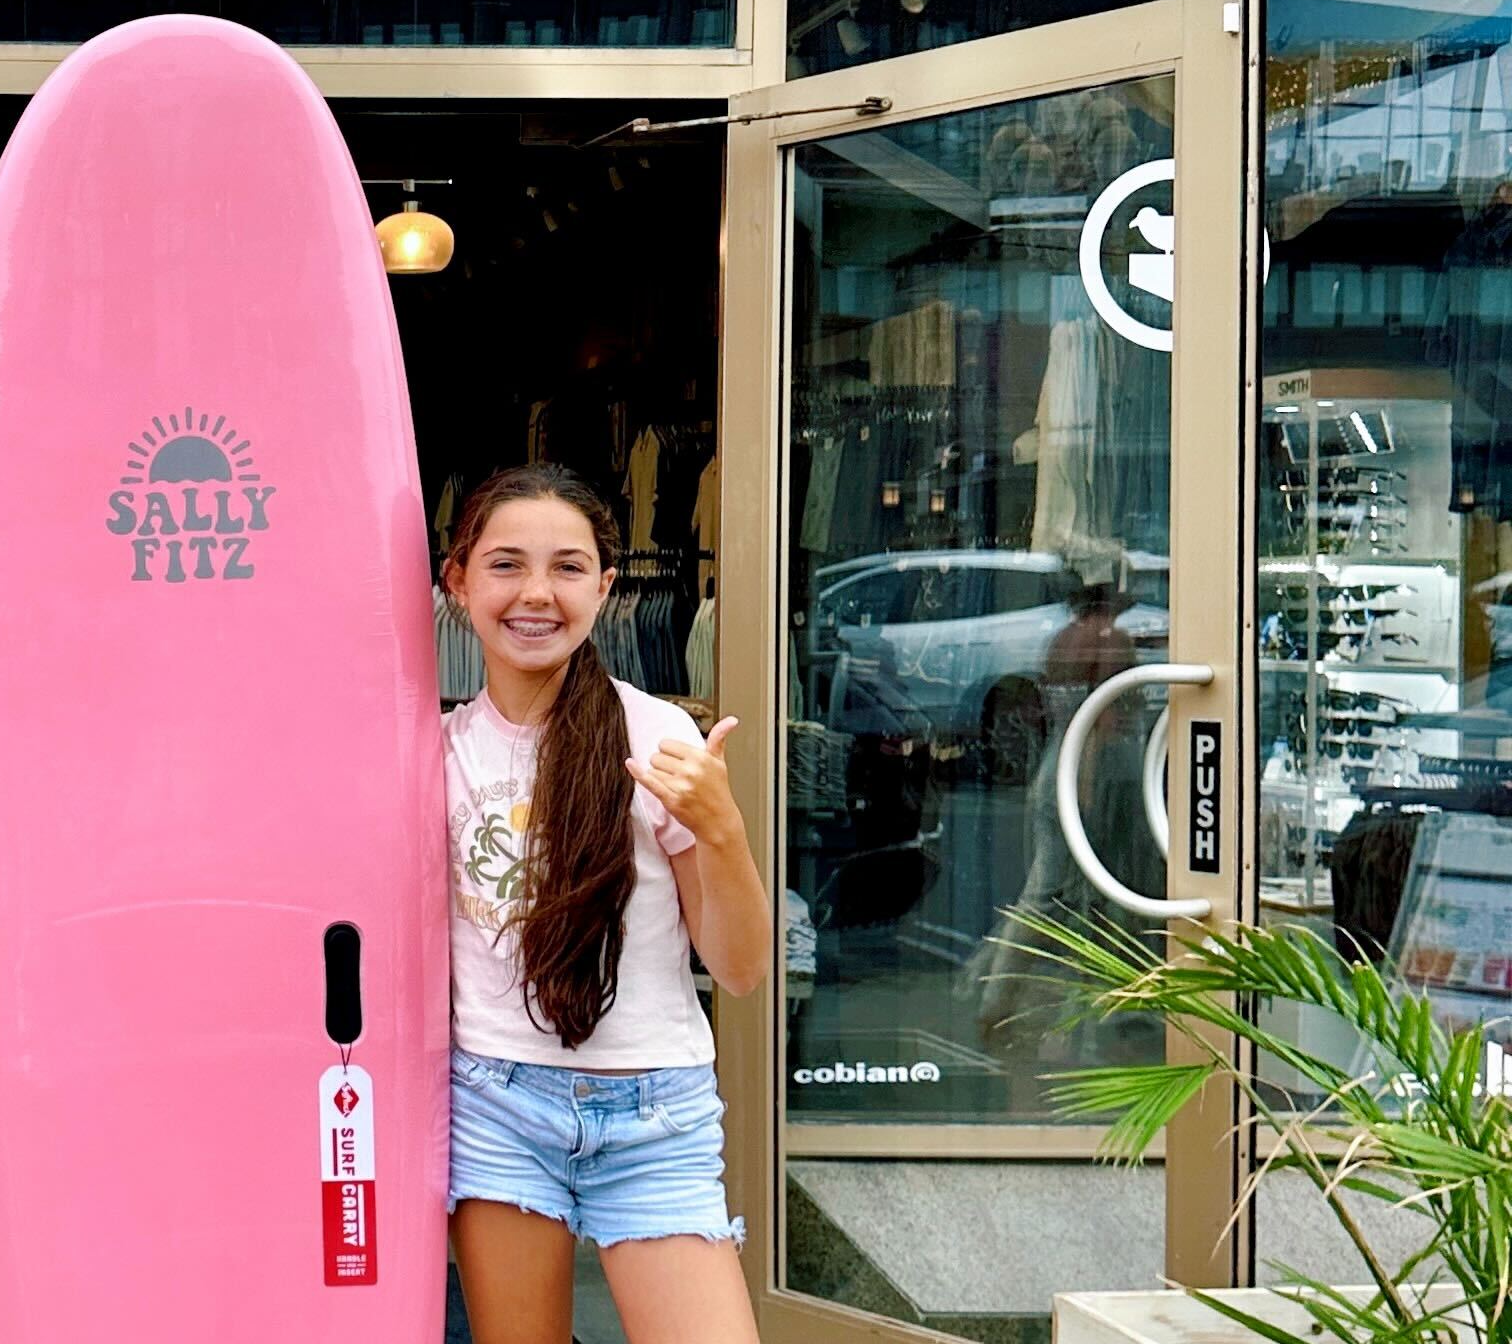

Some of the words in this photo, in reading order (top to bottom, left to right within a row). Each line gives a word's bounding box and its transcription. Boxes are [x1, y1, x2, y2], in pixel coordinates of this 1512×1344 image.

[105, 486, 277, 536] SALLY
[131, 536, 255, 583] FITZ
[1195, 734, 1216, 860] PUSH
[340, 1127, 356, 1177] SURF
[341, 1183, 359, 1247] CARRY
